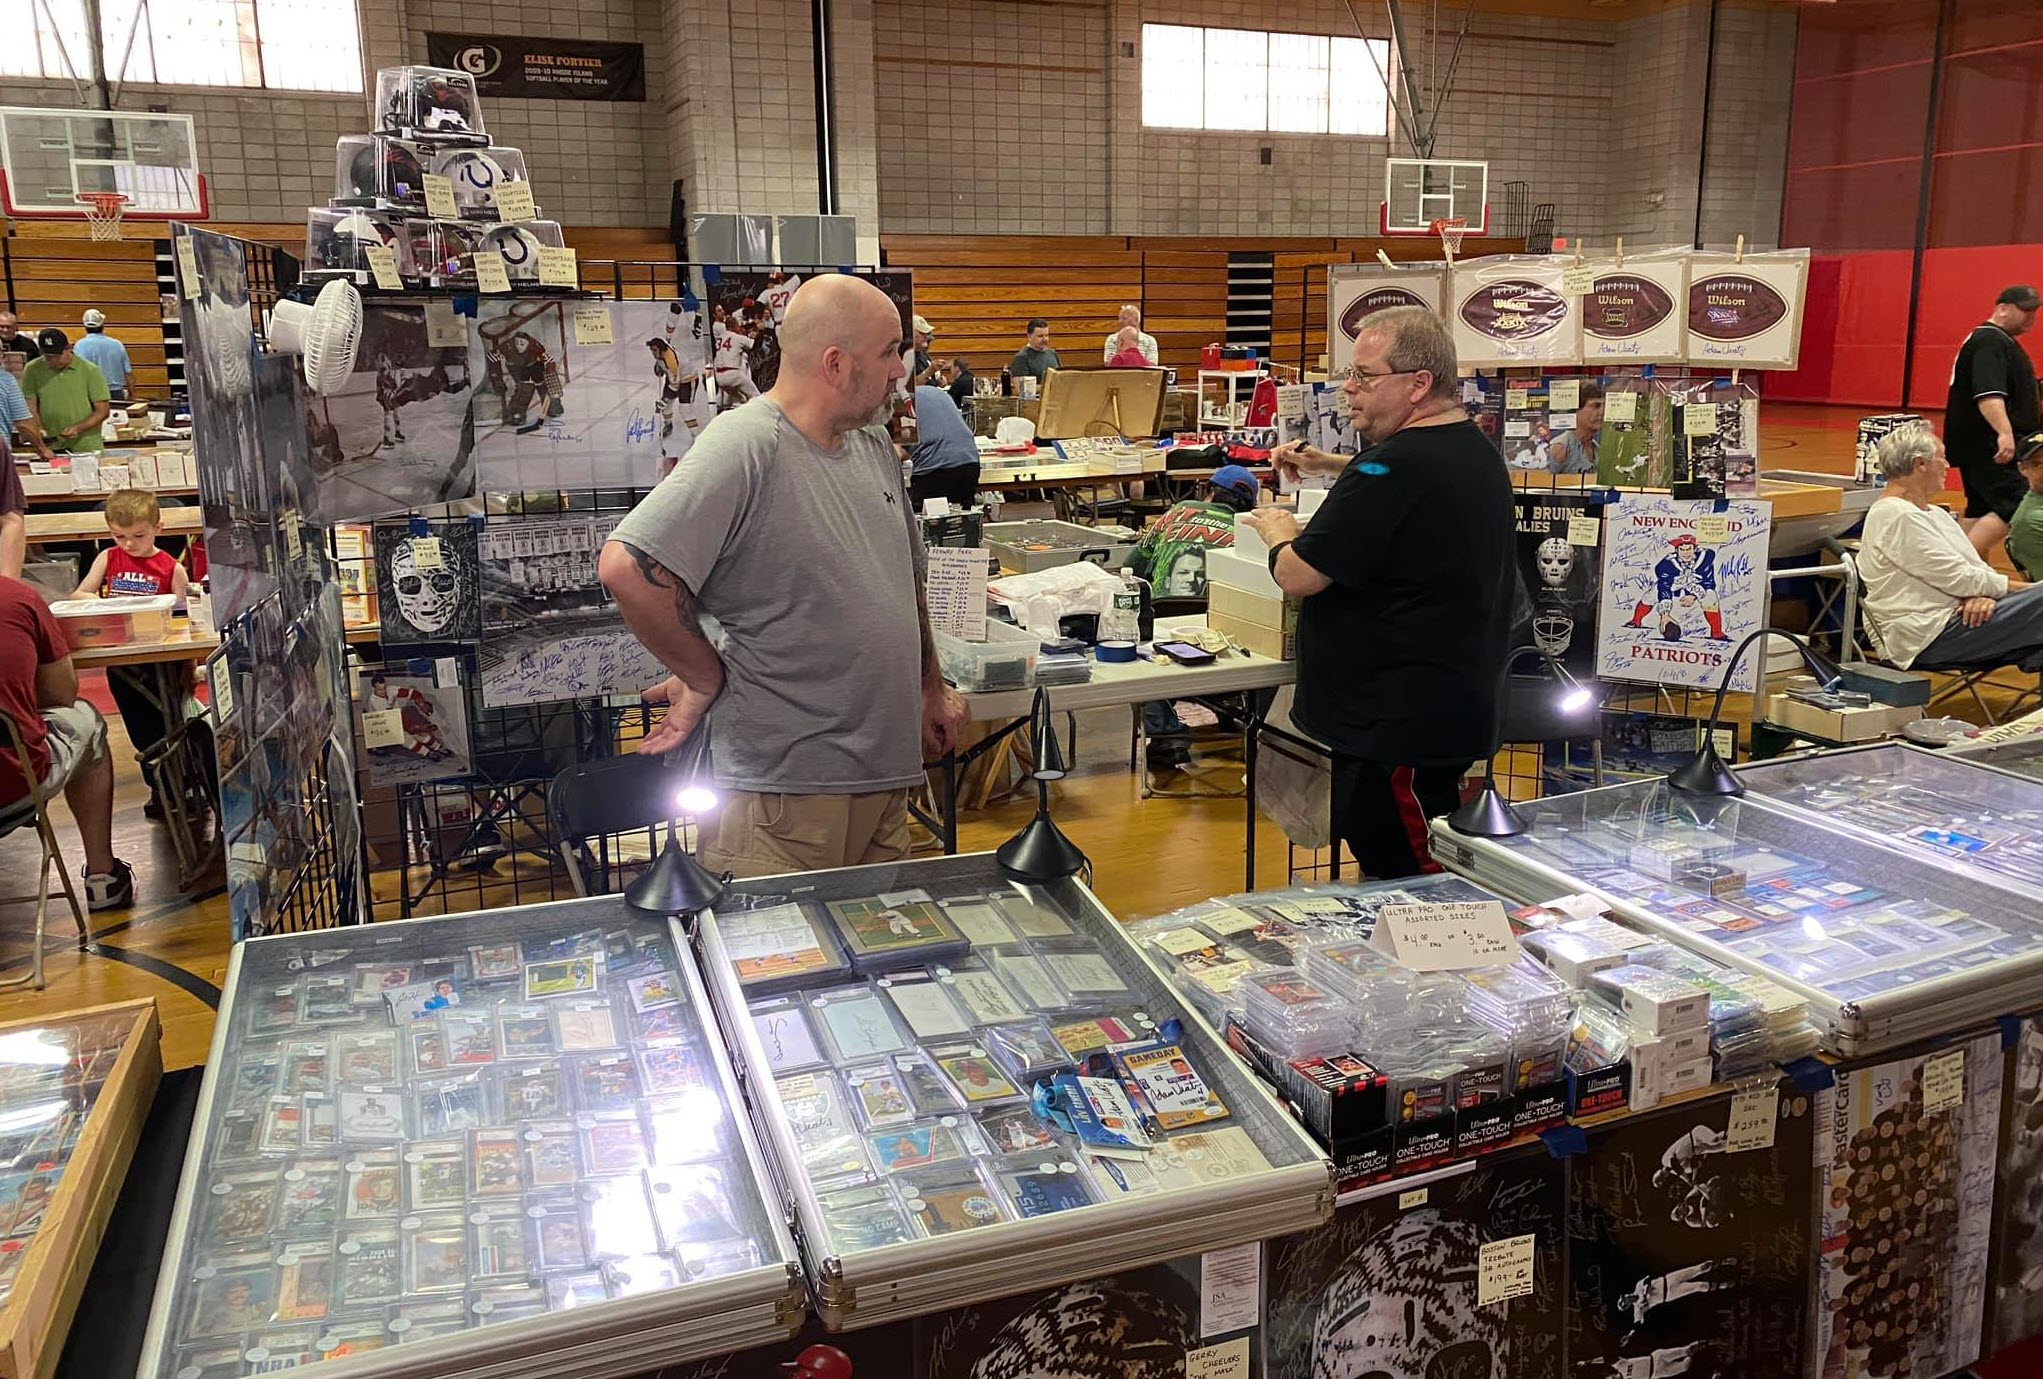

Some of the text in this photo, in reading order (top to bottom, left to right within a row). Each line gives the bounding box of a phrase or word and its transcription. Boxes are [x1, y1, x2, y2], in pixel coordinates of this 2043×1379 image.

[524, 54, 603, 68] ELISE FORTIER
[552, 68, 571, 77] RHODE
[572, 69, 593, 77] ISLAND
[525, 75, 552, 83] SOFTBALL
[552, 76, 573, 84] PLAYER
[582, 77, 593, 85] THE
[593, 78, 608, 86] YEAR
[770, 291, 790, 309] 27
[1493, 299, 1529, 309] Wilson
[1598, 295, 1634, 305] Wilson
[1707, 295, 1746, 306] Wilson
[715, 337, 732, 352] 34
[1532, 505, 1585, 521] BRUINS
[1515, 520, 1551, 533] ALIES
[1632, 516, 1743, 532] NEW ENGD
[123, 571, 147, 582] ALL
[1631, 645, 1723, 667] PATRIOTS
[1386, 903, 1488, 917] ULTRA PRO ONE TOUCH
[1405, 912, 1476, 924] ASSORTED SIZES
[1129, 1048, 1176, 1063] GAMEDAY
[1514, 1102, 1565, 1123] ONE-TOUCH
[1458, 1122, 1511, 1143] ONE-TOUCH
[1396, 1138, 1450, 1158] ONE-TOUCH
[1189, 1349, 1219, 1363] GERRY
[1202, 1354, 1241, 1369] CHEEVERS
